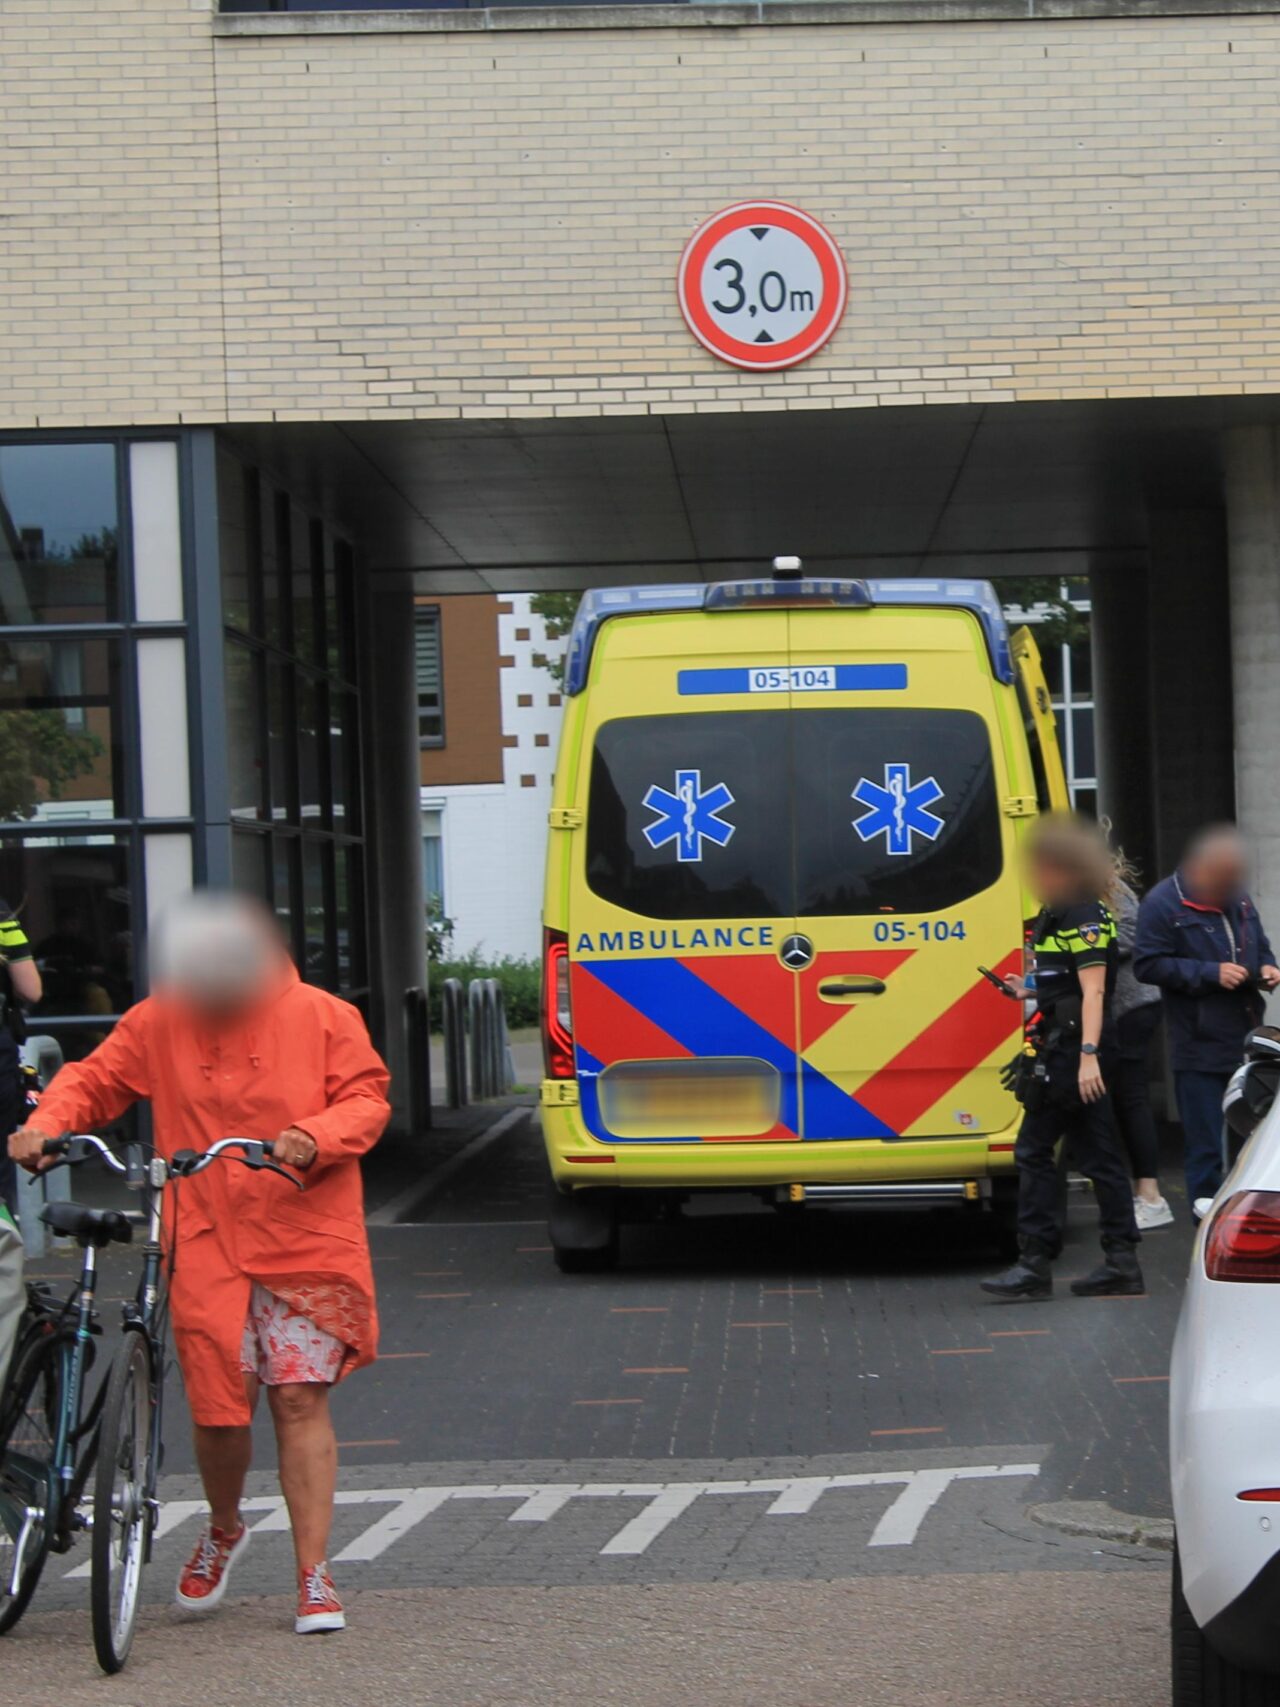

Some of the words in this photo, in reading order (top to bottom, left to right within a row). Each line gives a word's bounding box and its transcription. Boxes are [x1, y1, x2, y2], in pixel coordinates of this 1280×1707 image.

[712, 258, 814, 317] 3,0m
[755, 670, 829, 688] 05-104
[576, 926, 774, 952] AMBULANCE
[874, 921, 966, 942] 05-104
